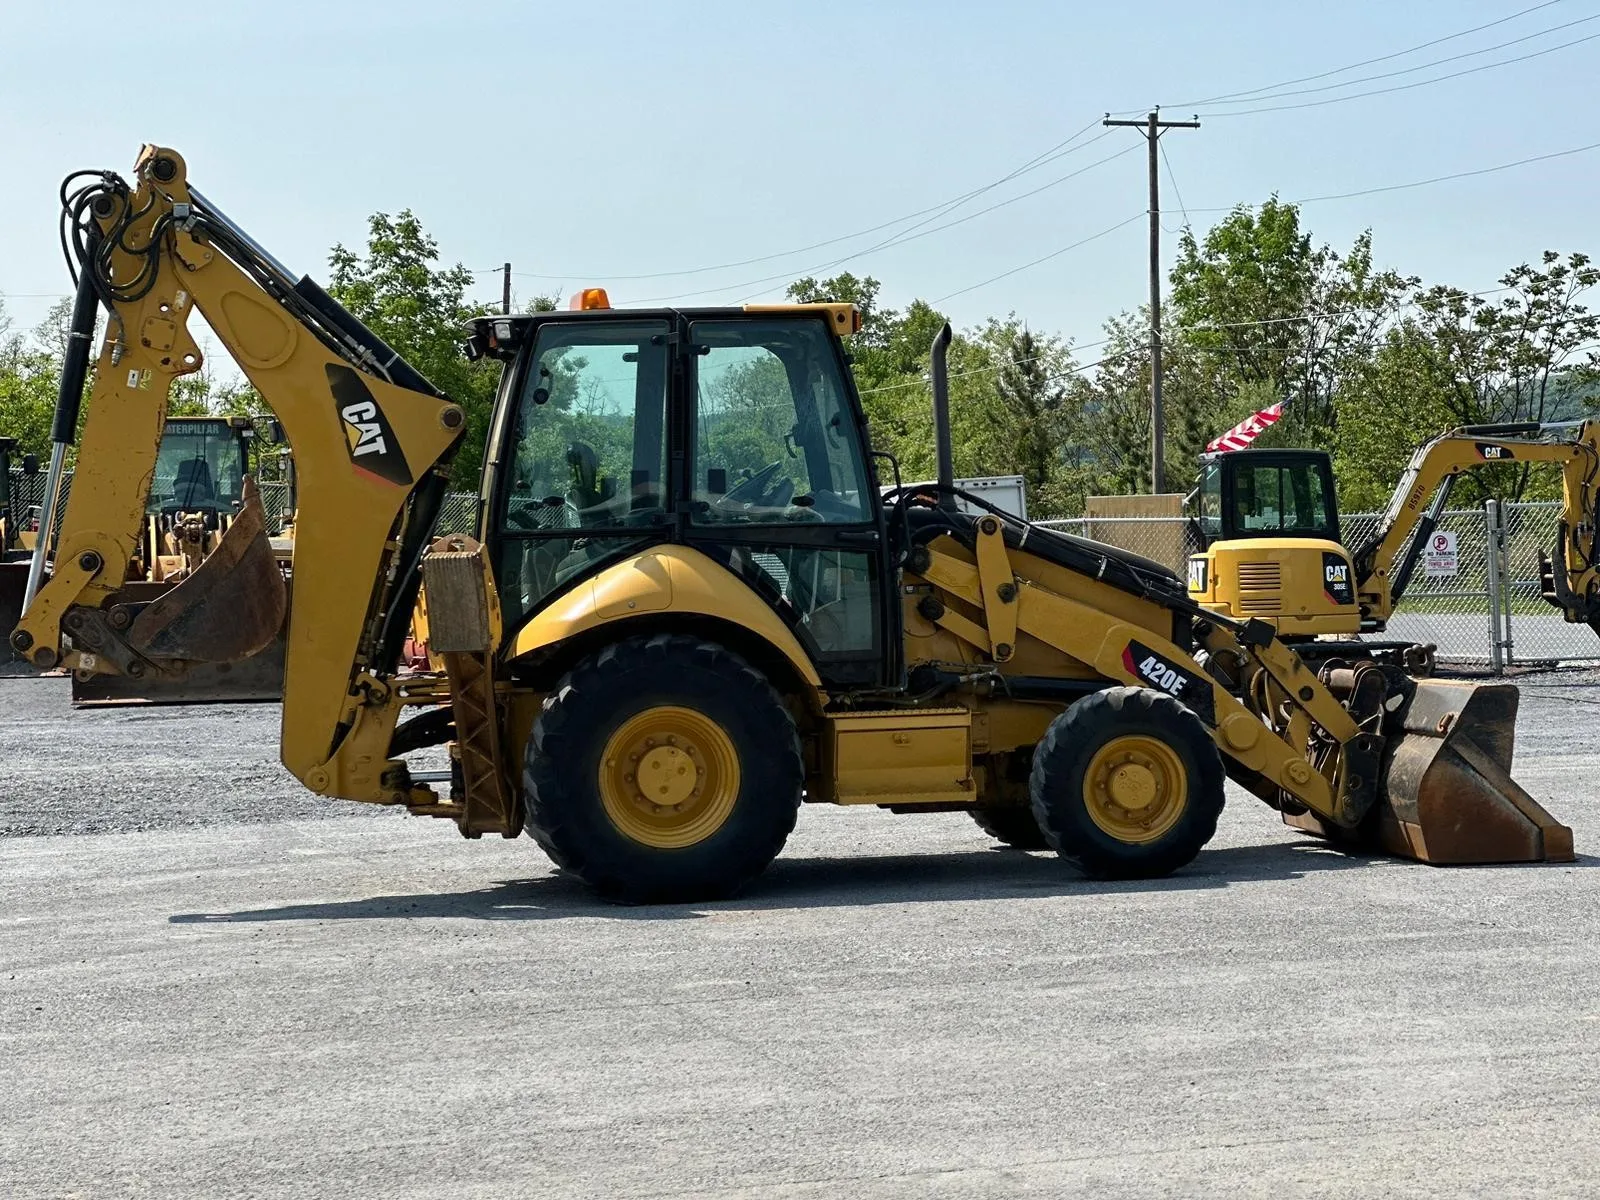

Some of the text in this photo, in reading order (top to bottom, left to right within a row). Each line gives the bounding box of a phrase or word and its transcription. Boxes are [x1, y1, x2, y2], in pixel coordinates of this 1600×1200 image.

[165, 423, 220, 435] ATERPILLAR
[342, 401, 387, 457] CAT
[1485, 447, 1501, 458] CAT
[1325, 565, 1347, 582] CAT
[1139, 656, 1187, 696] 420E
